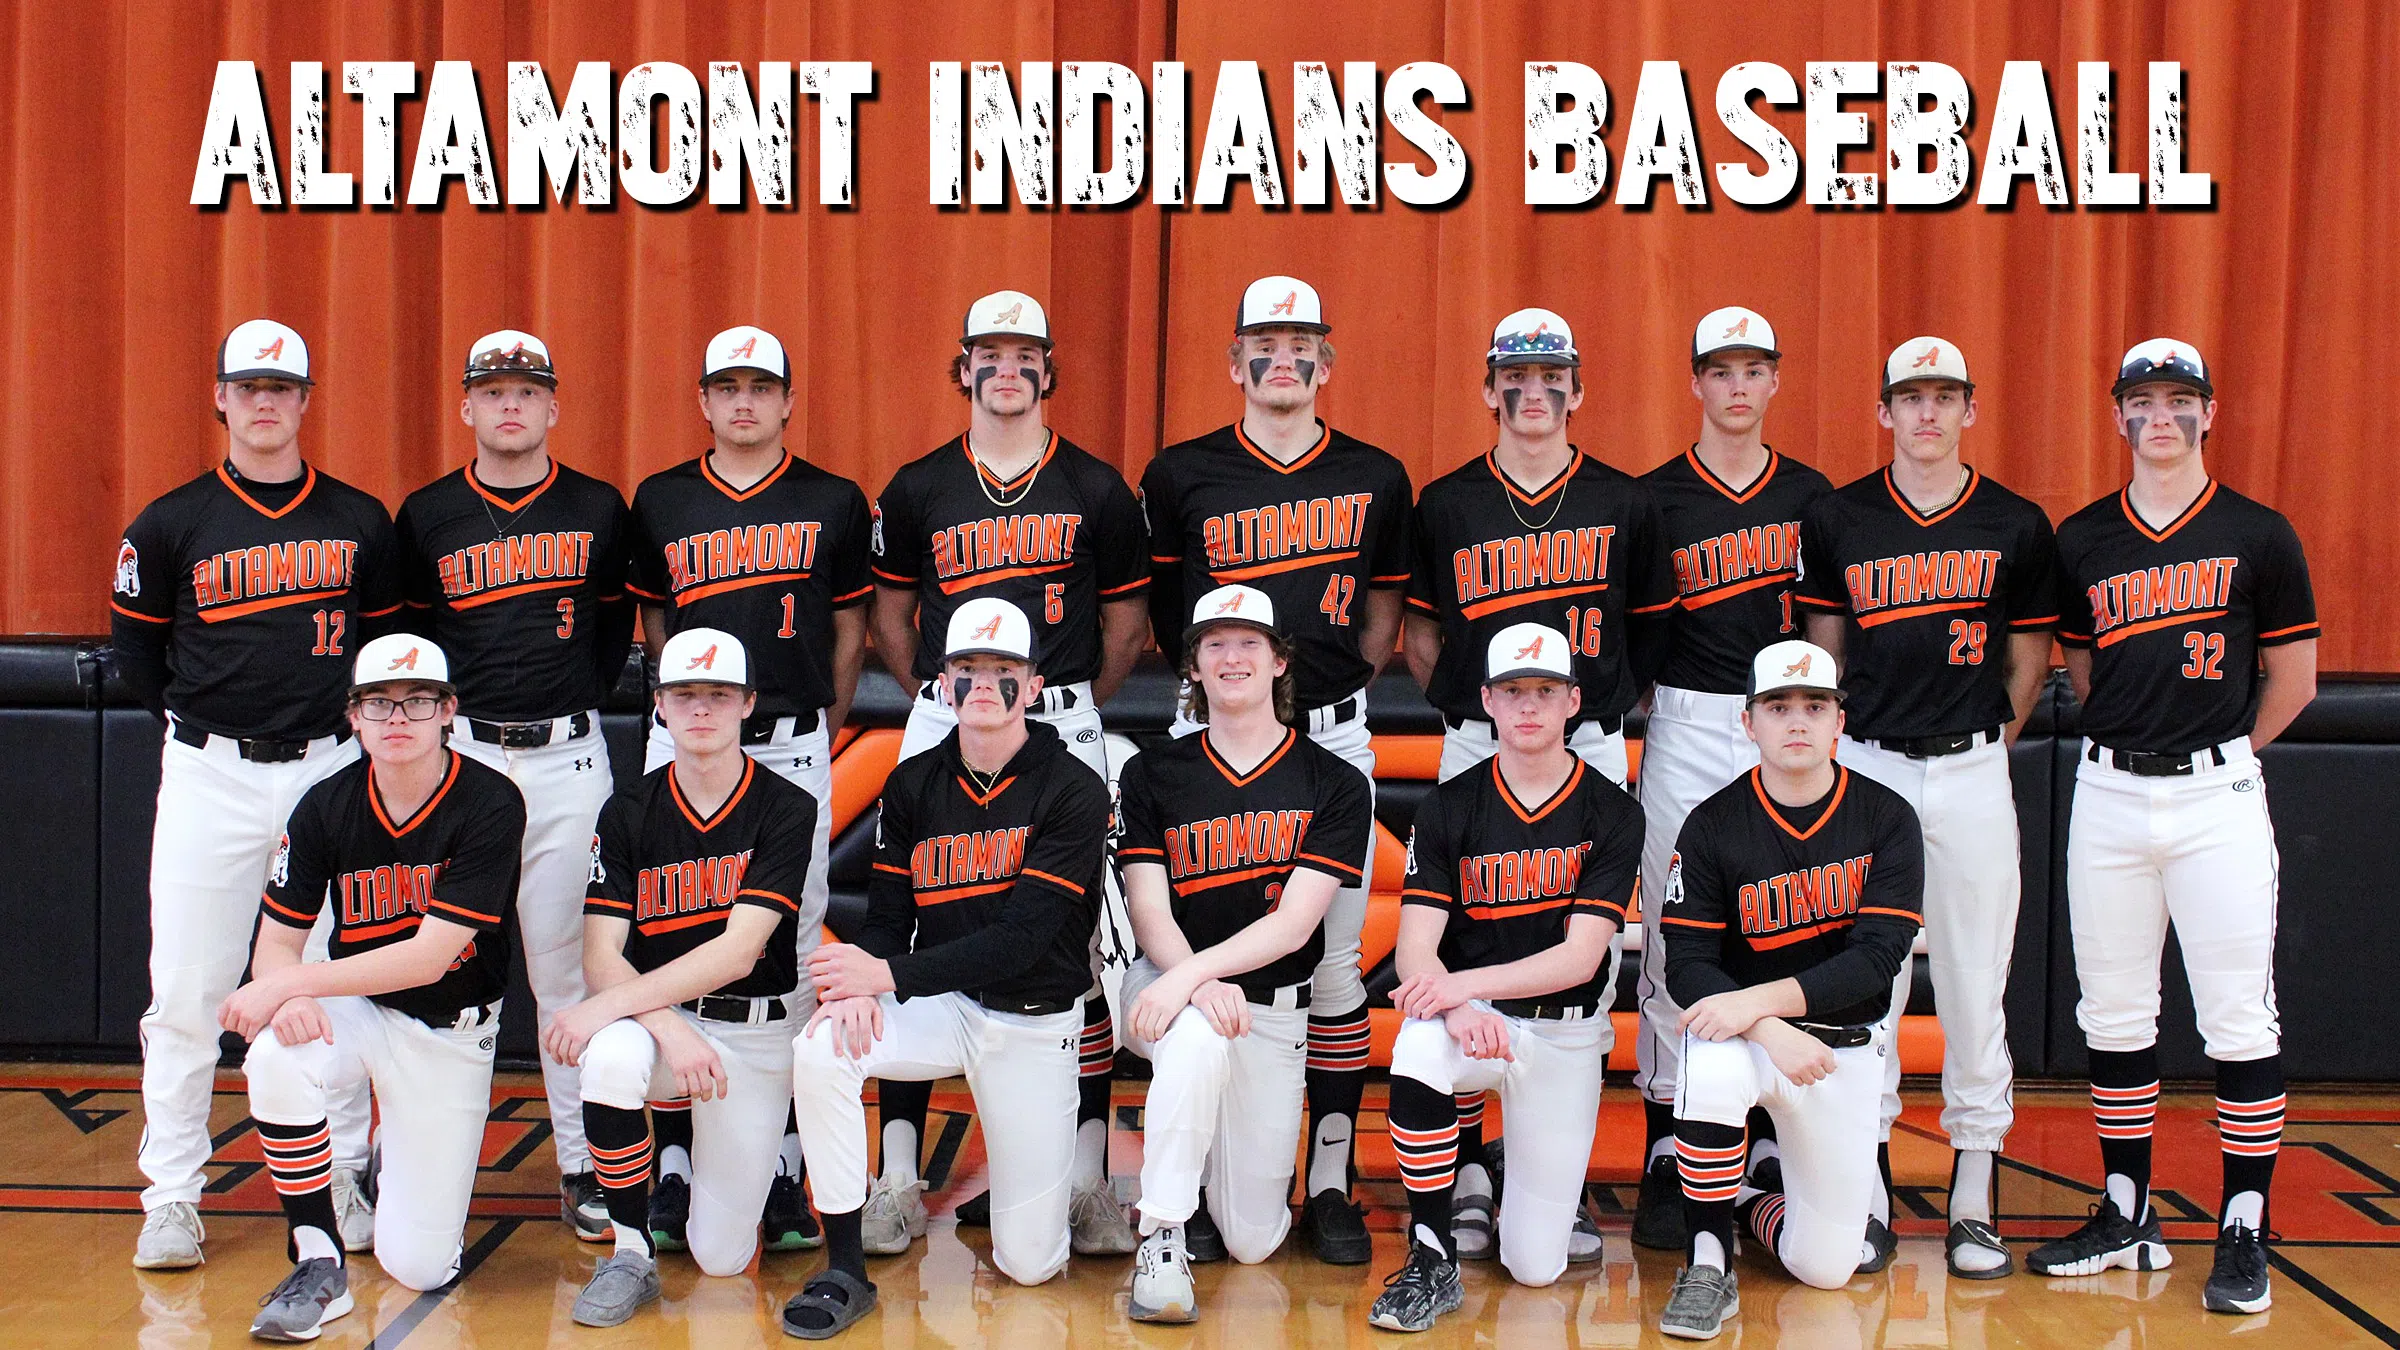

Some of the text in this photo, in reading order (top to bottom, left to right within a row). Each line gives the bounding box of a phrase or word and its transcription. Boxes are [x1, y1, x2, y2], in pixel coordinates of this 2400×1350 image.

[993, 302, 1023, 326] A
[1269, 289, 1297, 316] A
[255, 336, 285, 361] A
[727, 336, 756, 360] A
[1722, 316, 1749, 339] A
[1911, 346, 1940, 368] A
[931, 513, 1082, 578] ALTAMONT
[1203, 492, 1373, 568] ALTAMONT
[193, 539, 358, 607] ALTAMONT
[437, 531, 594, 598] ALTAMONT
[664, 521, 821, 592] ALTAMONT
[1452, 525, 1616, 604] ALTAMONT
[1671, 521, 1801, 595] ALTAMON
[1044, 583, 1065, 625] 6
[1215, 591, 1246, 616] A
[1320, 574, 1355, 627] 42
[1845, 550, 2002, 613] ALTAMONT
[2086, 557, 2238, 634] ALTAMONT
[312, 609, 344, 655] 12
[556, 598, 574, 640] 3
[777, 593, 796, 640] 1
[971, 613, 1002, 641] A
[1567, 606, 1603, 657] 16
[388, 646, 420, 671] A
[686, 643, 717, 670] A
[1514, 635, 1544, 661] A
[1782, 652, 1812, 678] A
[1948, 618, 1988, 665] 29
[2182, 632, 2225, 680] 32
[909, 824, 1034, 889] ALTAMON
[1164, 809, 1314, 879] ALTAMONT
[636, 848, 755, 920] ALTAMON
